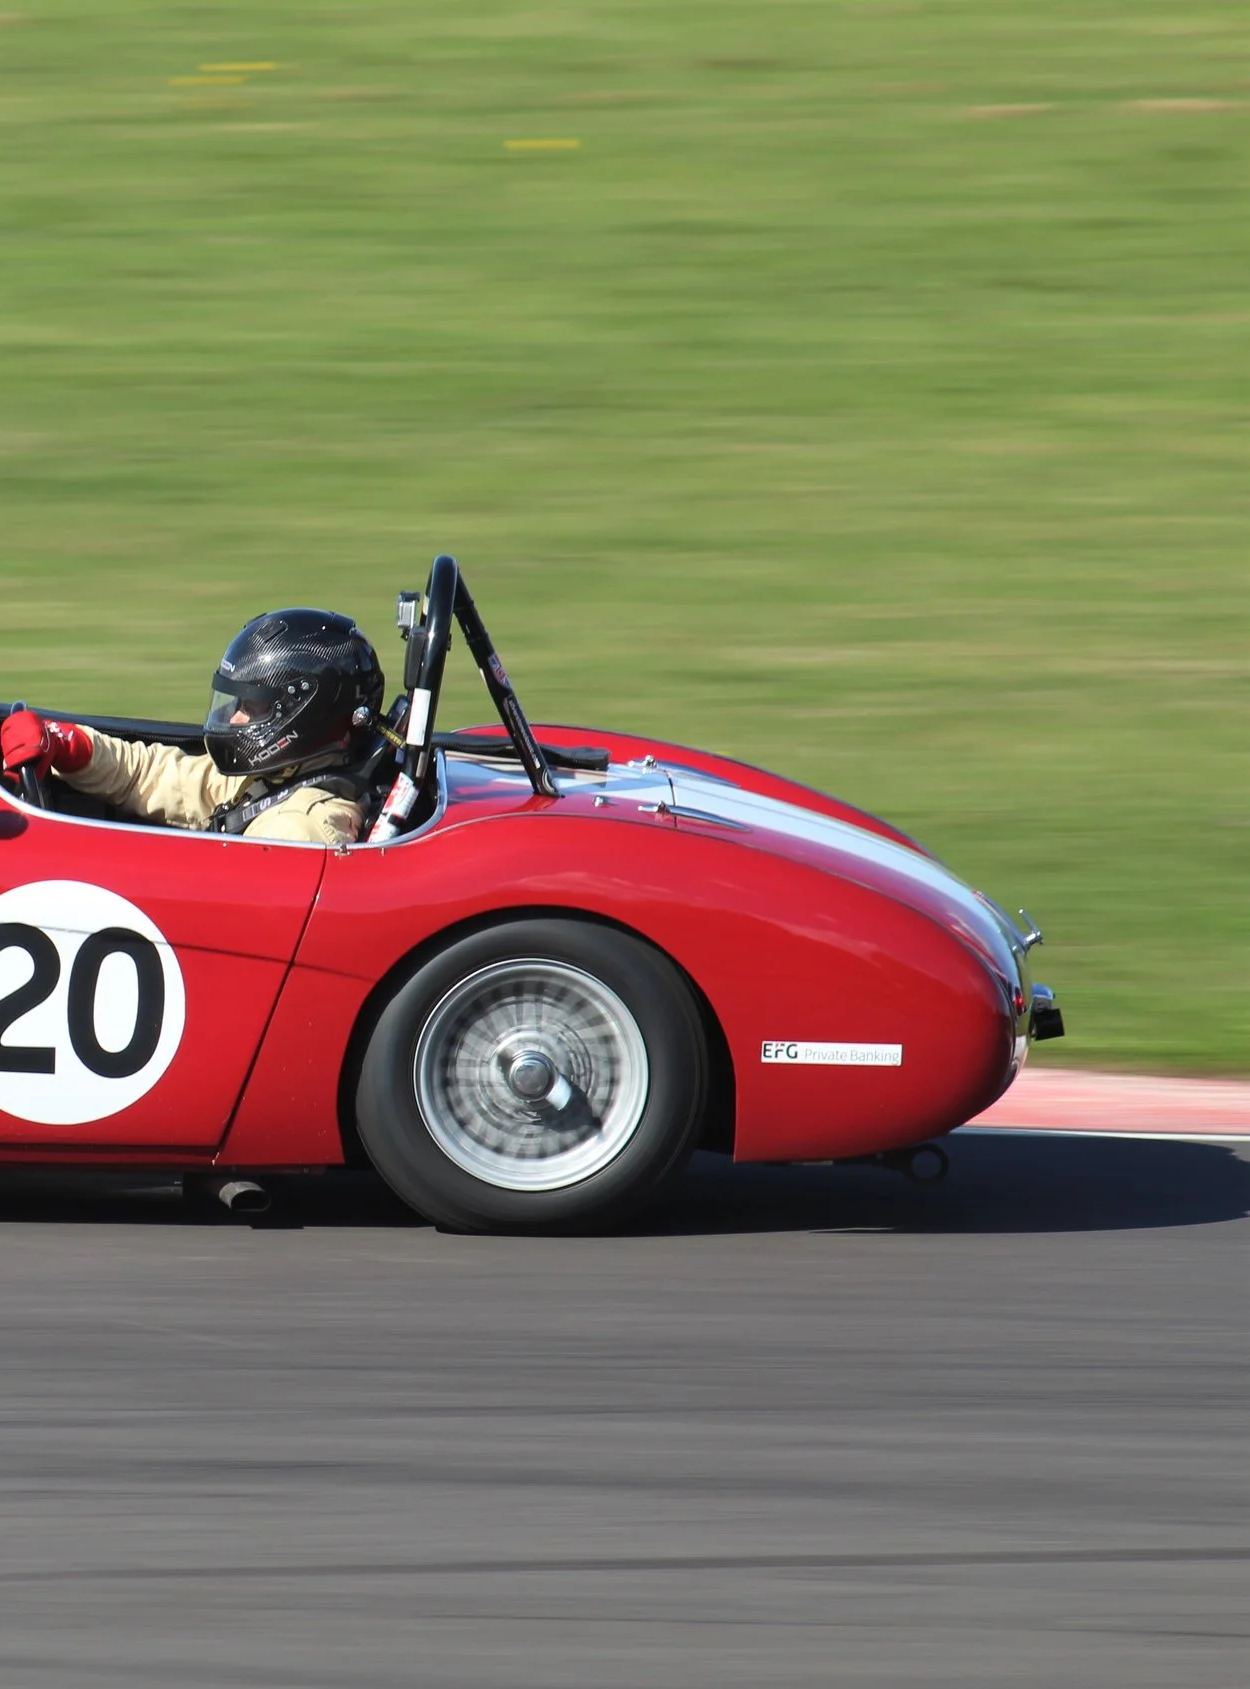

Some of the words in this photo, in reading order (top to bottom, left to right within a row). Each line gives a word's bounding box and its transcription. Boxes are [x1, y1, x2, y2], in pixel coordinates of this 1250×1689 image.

[763, 1043, 798, 1059] EFG
[804, 1048, 848, 1061] Private
[850, 1050, 900, 1066] Banking
